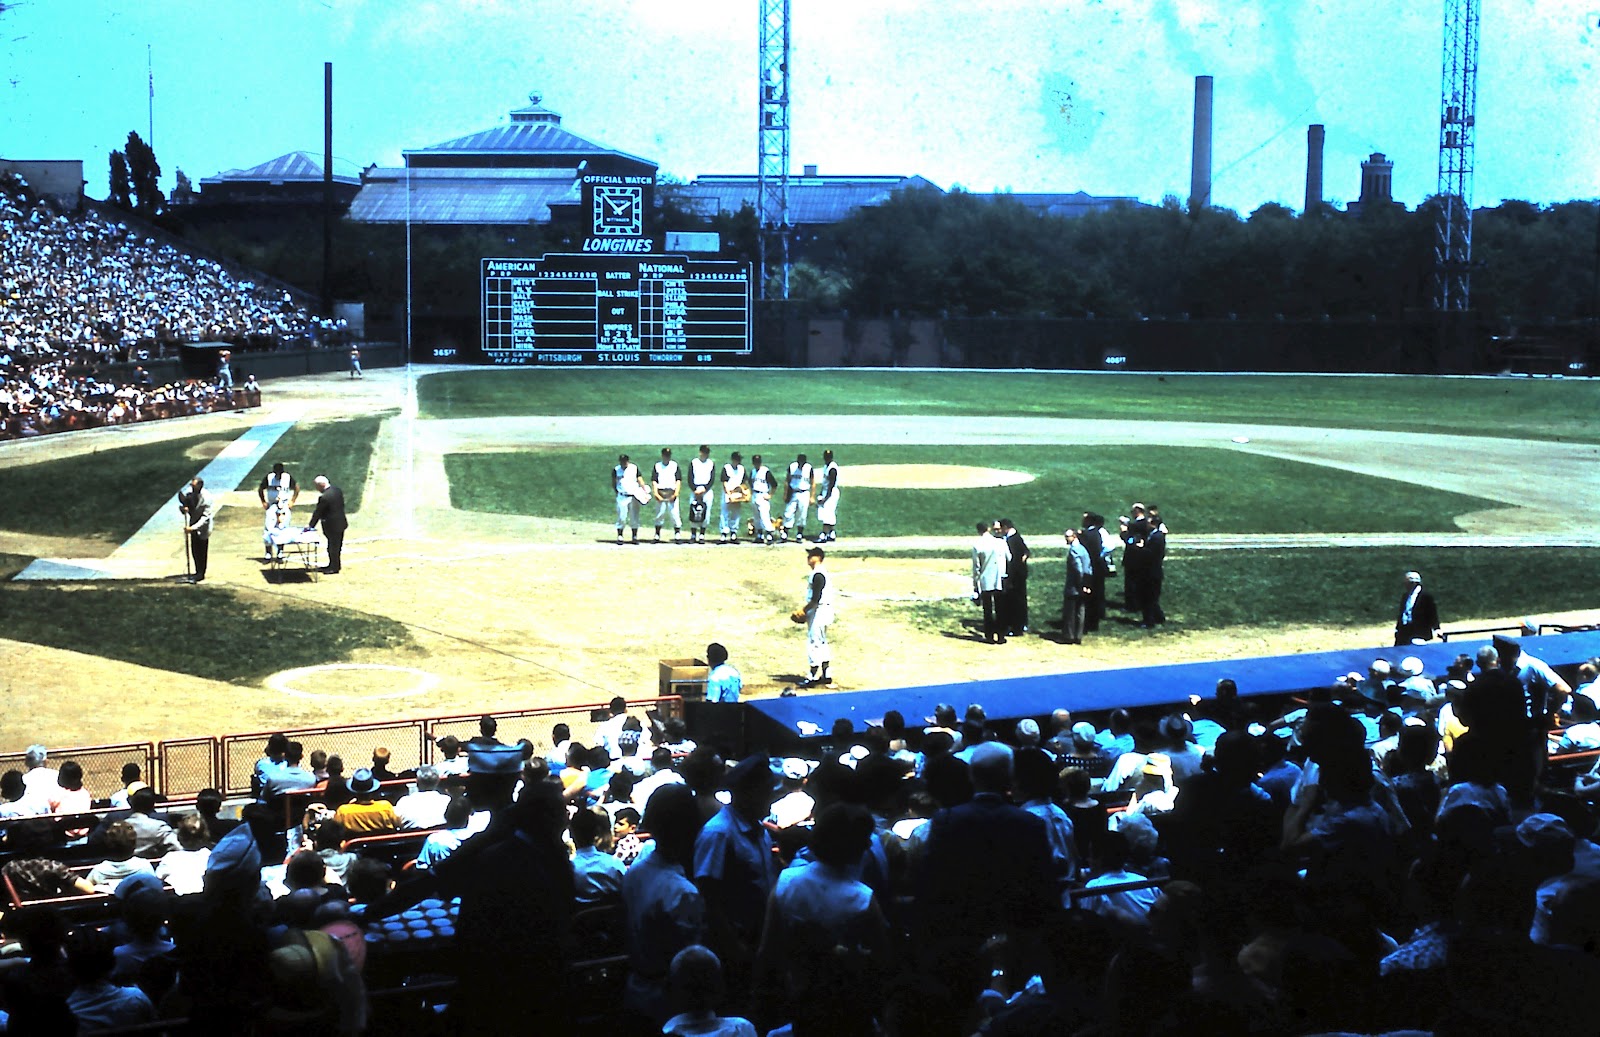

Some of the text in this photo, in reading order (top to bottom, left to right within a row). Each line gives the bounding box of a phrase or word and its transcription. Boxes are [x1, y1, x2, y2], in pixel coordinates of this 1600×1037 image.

[583, 176, 622, 184] OFFICIAL
[582, 238, 653, 252] LONGINES
[487, 261, 536, 271] AMERICAN
[639, 263, 685, 273] NATIONAL
[538, 354, 582, 362] PITTSBURGH
